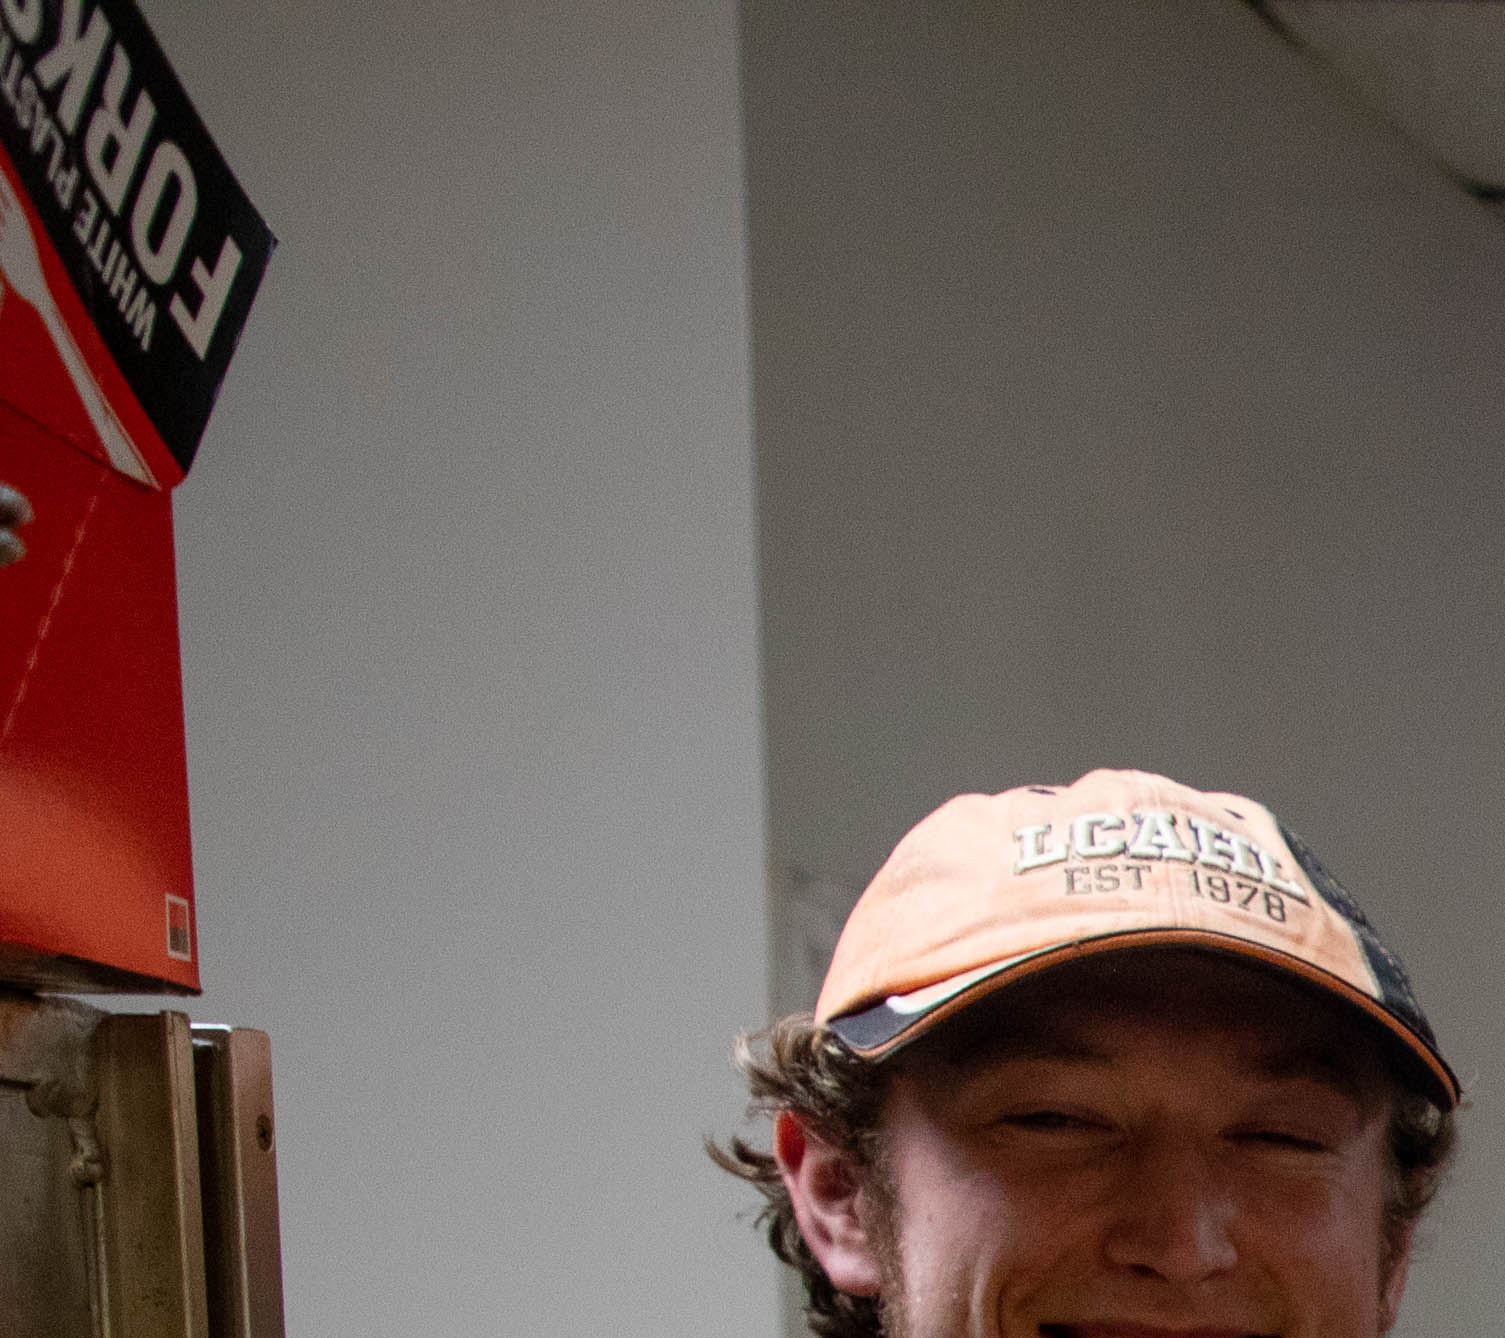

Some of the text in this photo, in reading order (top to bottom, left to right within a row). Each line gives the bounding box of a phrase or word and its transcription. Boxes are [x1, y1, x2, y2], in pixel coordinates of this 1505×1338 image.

[73, 188, 157, 352] WHITE
[1063, 865, 1287, 914] EST 1978
